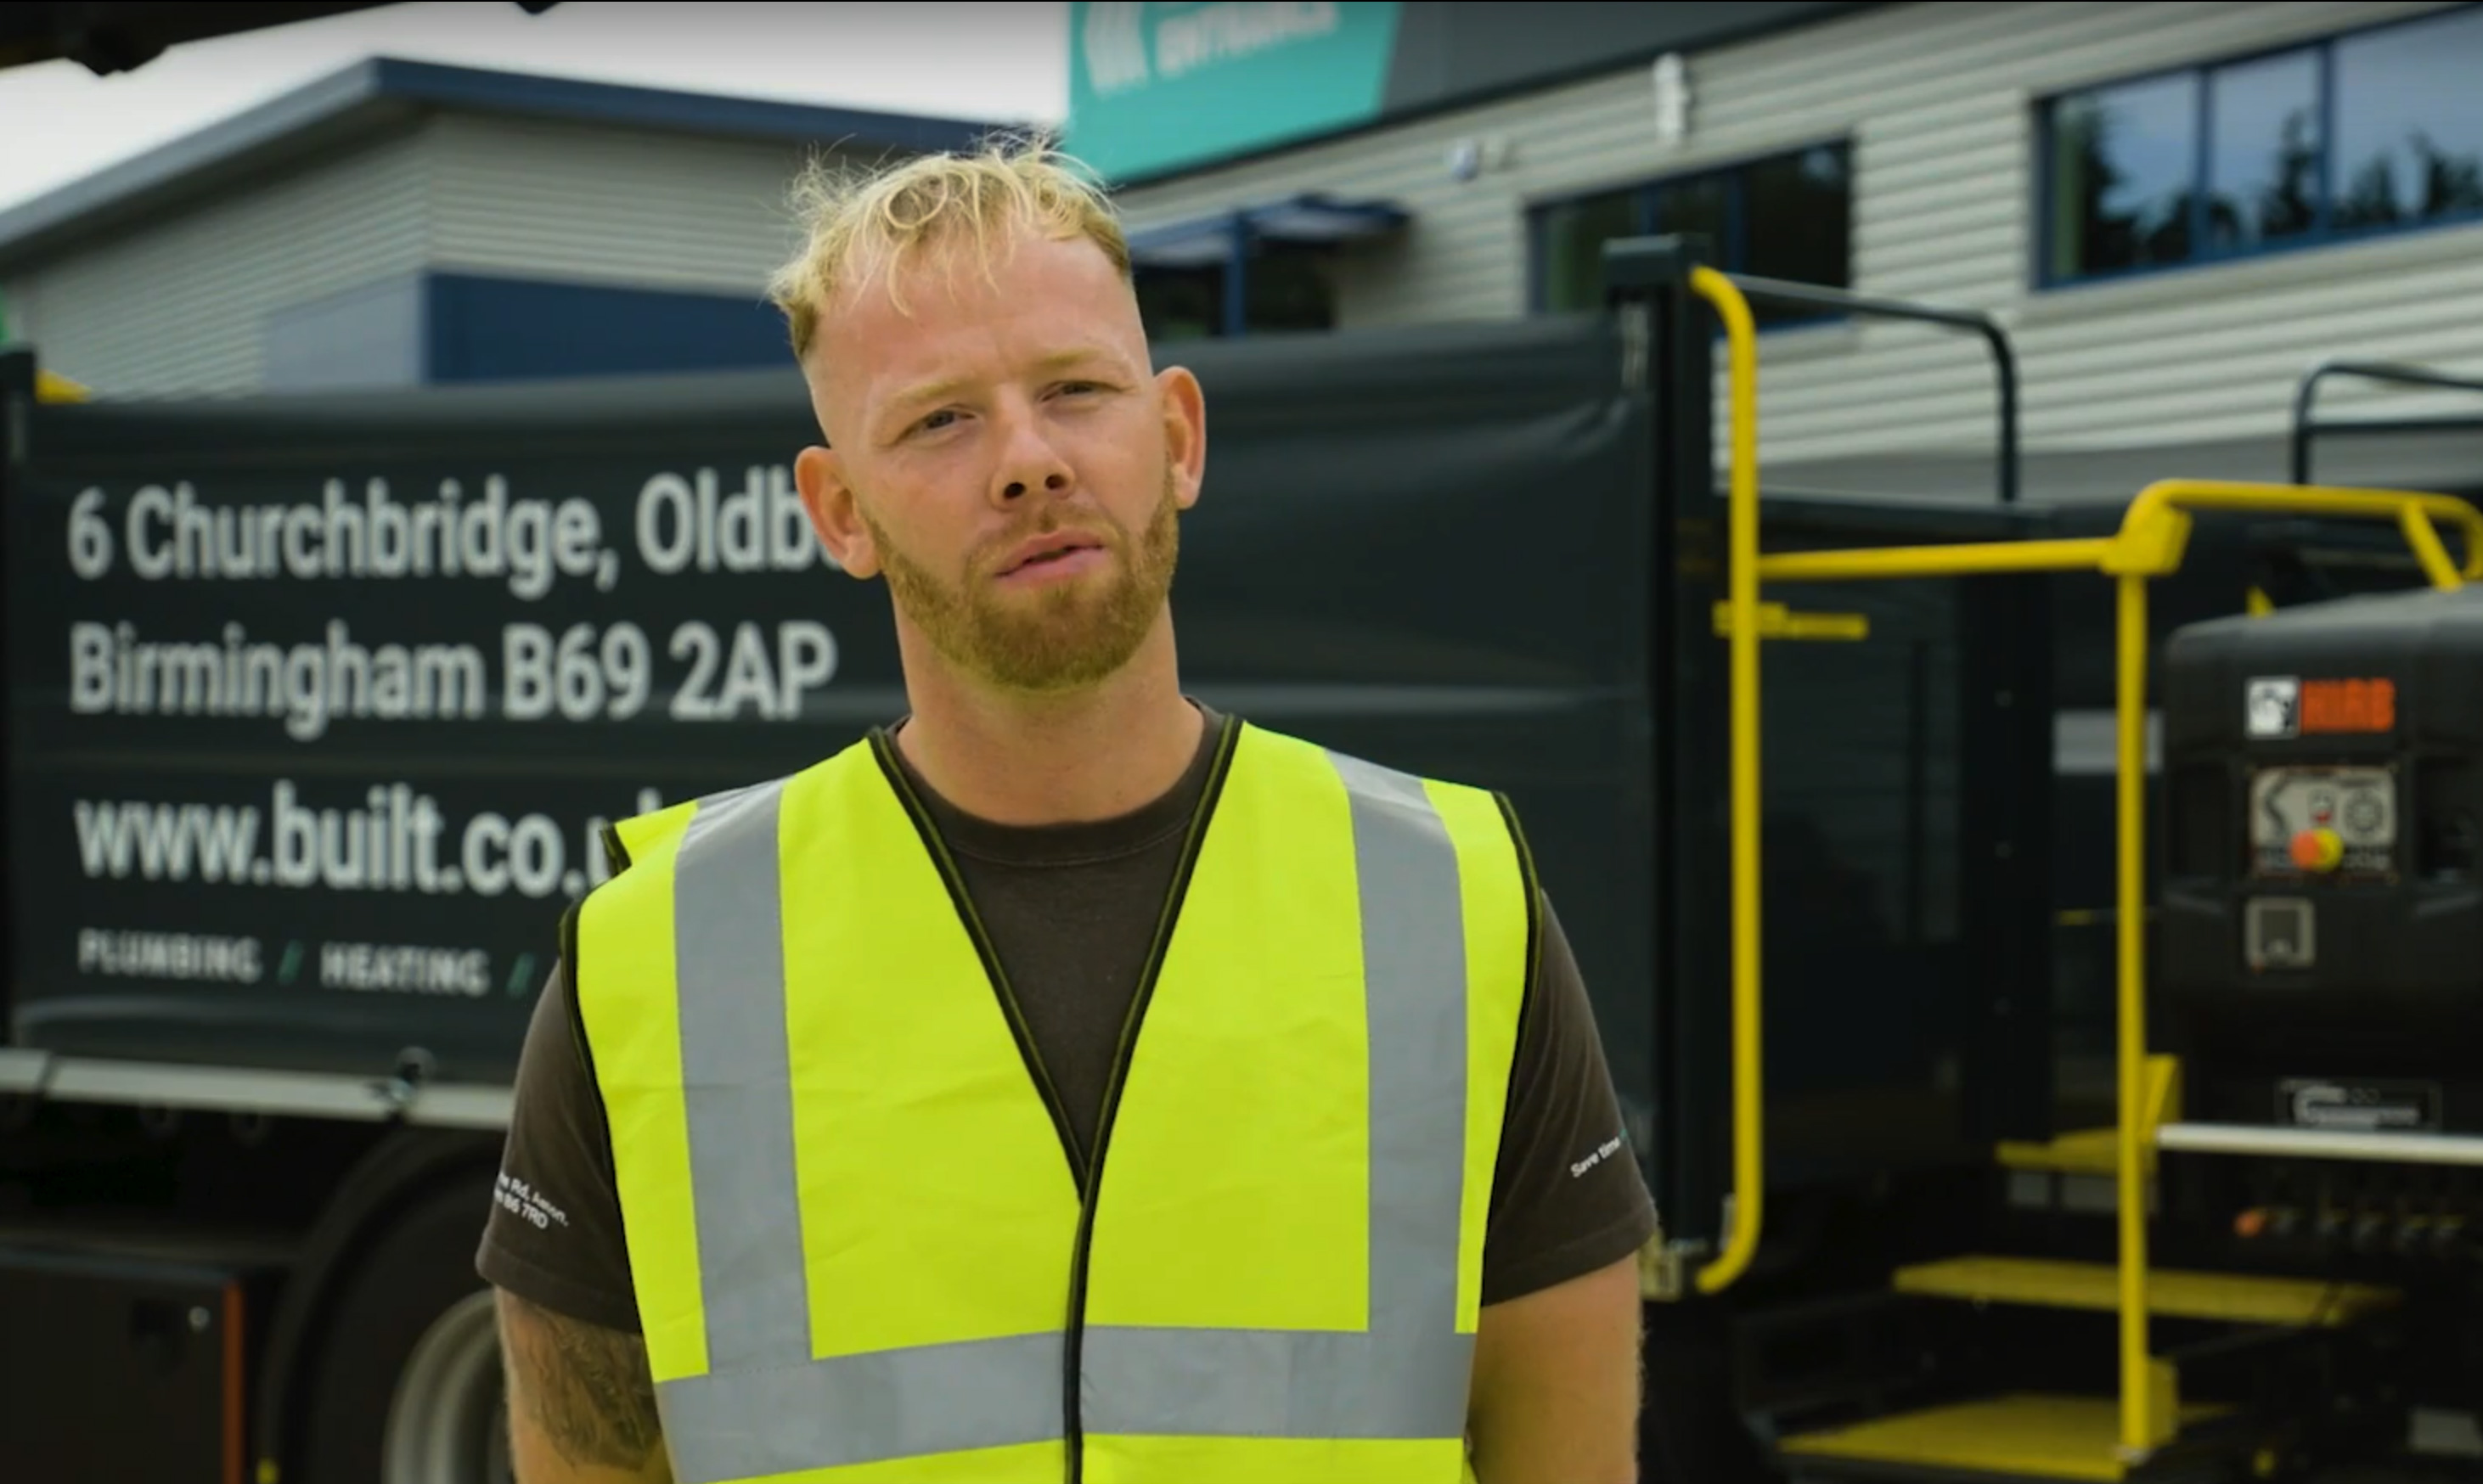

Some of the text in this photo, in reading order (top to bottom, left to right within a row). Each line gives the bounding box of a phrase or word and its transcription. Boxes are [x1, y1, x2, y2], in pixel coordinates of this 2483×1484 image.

[69, 464, 842, 599] 6 Churchbridge, Oldb
[71, 620, 837, 740] Birmingham B69 2AP
[79, 928, 263, 985] PLUMBING
[319, 942, 492, 997] HEATING
